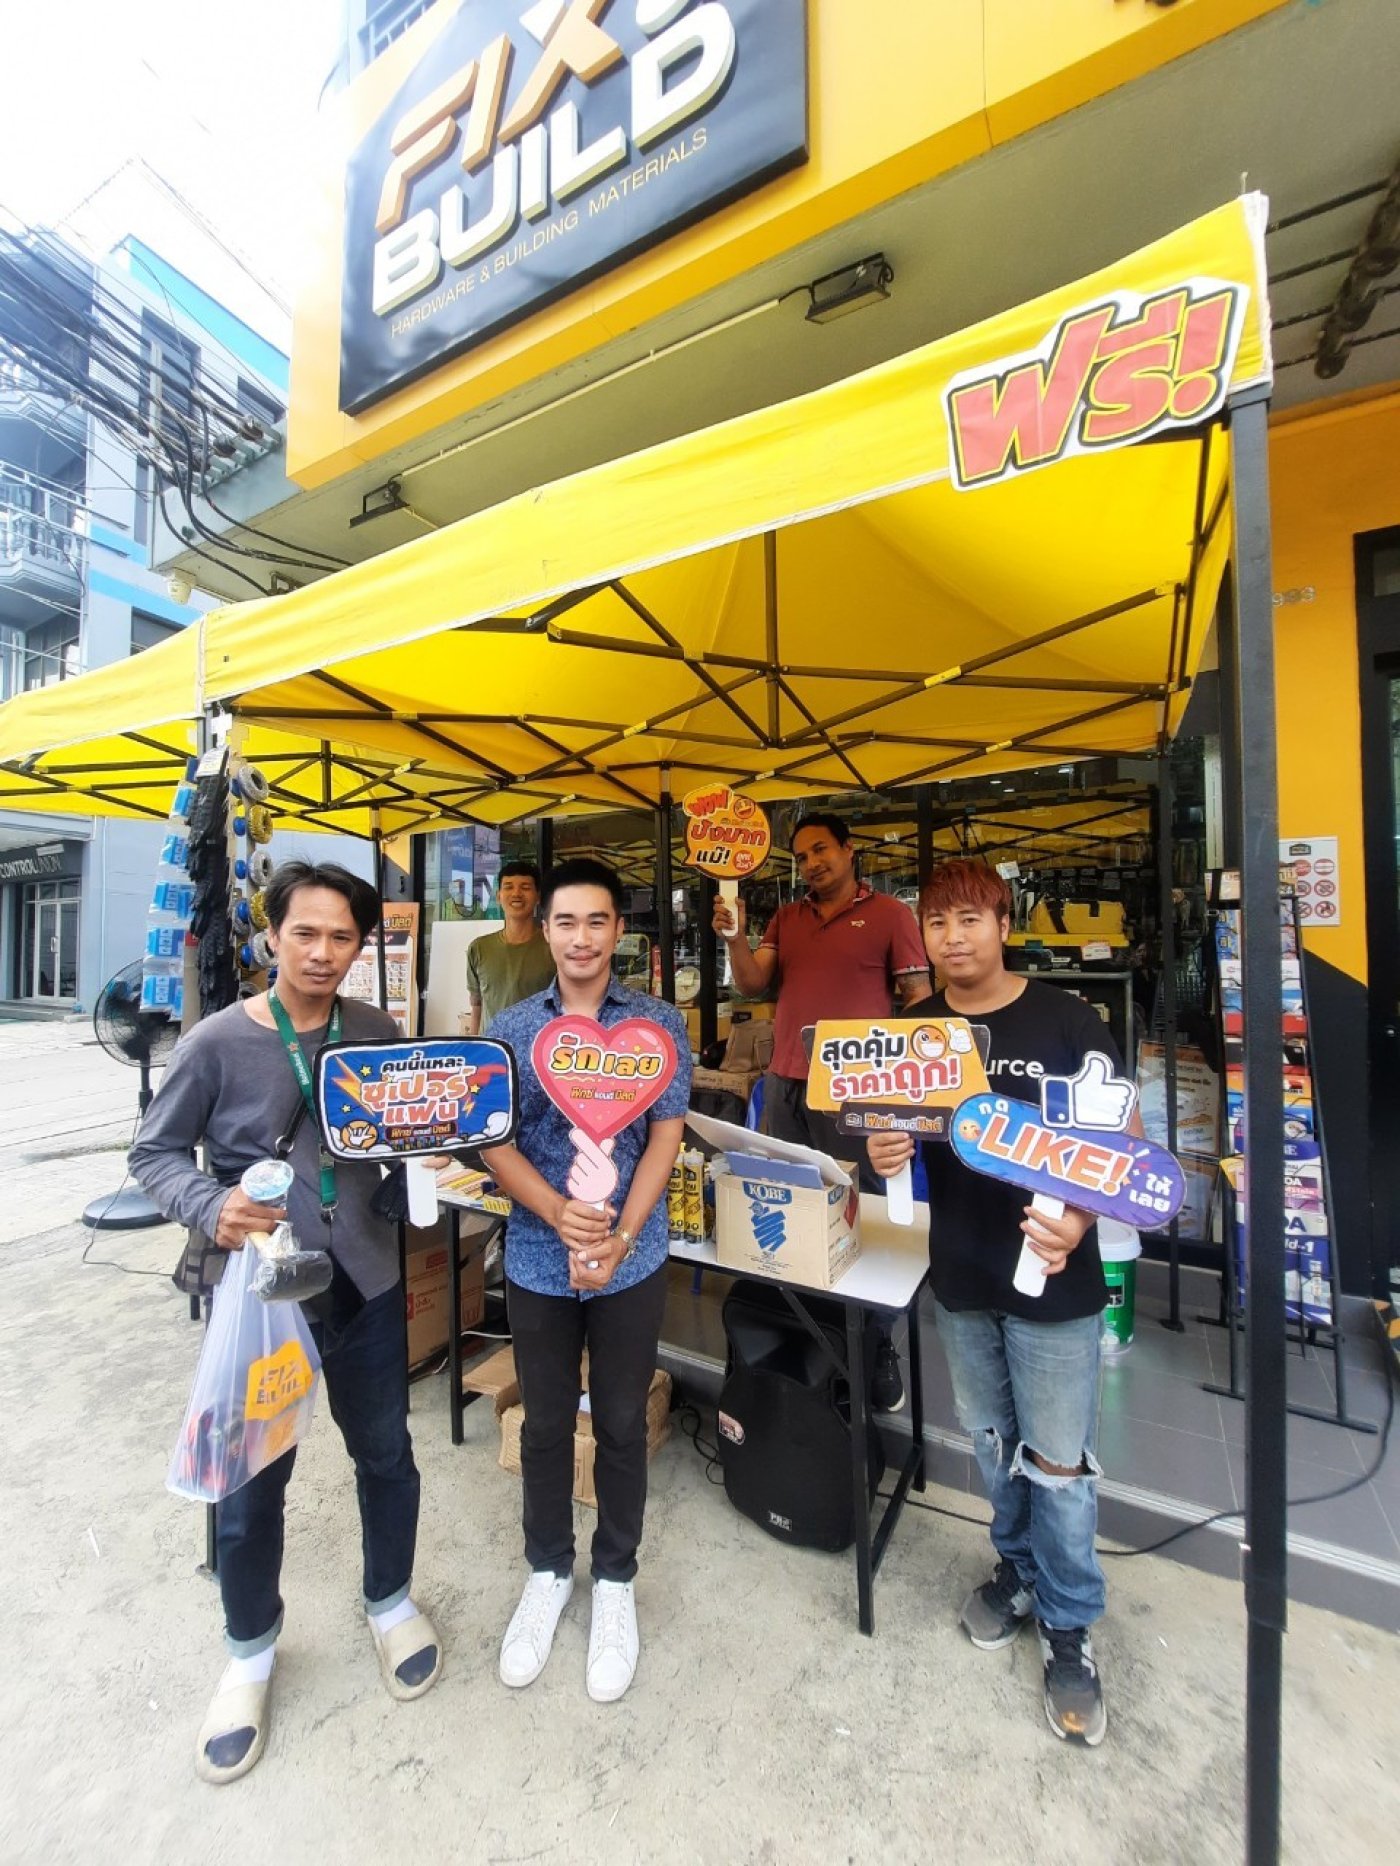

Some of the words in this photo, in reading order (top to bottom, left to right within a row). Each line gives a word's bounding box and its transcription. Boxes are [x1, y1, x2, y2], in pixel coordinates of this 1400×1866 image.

[375, 0, 624, 237] FIX
[372, 2, 736, 316] BUILD
[390, 276, 476, 338] HARDWARE
[479, 264, 492, 285] &
[494, 210, 579, 275] BUILDING
[588, 127, 708, 217] MATERIALS
[950, 286, 1238, 488] ฟรี!
[382, 1050, 464, 1072] คนนี้แหละ
[822, 1028, 905, 1071] สุดคุ้ม
[831, 1057, 959, 1099] ราคาถูก!
[384, 1099, 458, 1125] แฟน
[978, 1100, 1009, 1115] กด
[978, 1113, 1134, 1196] LIKE!
[748, 1185, 787, 1202] KOBE
[1129, 1188, 1171, 1213] เลย
